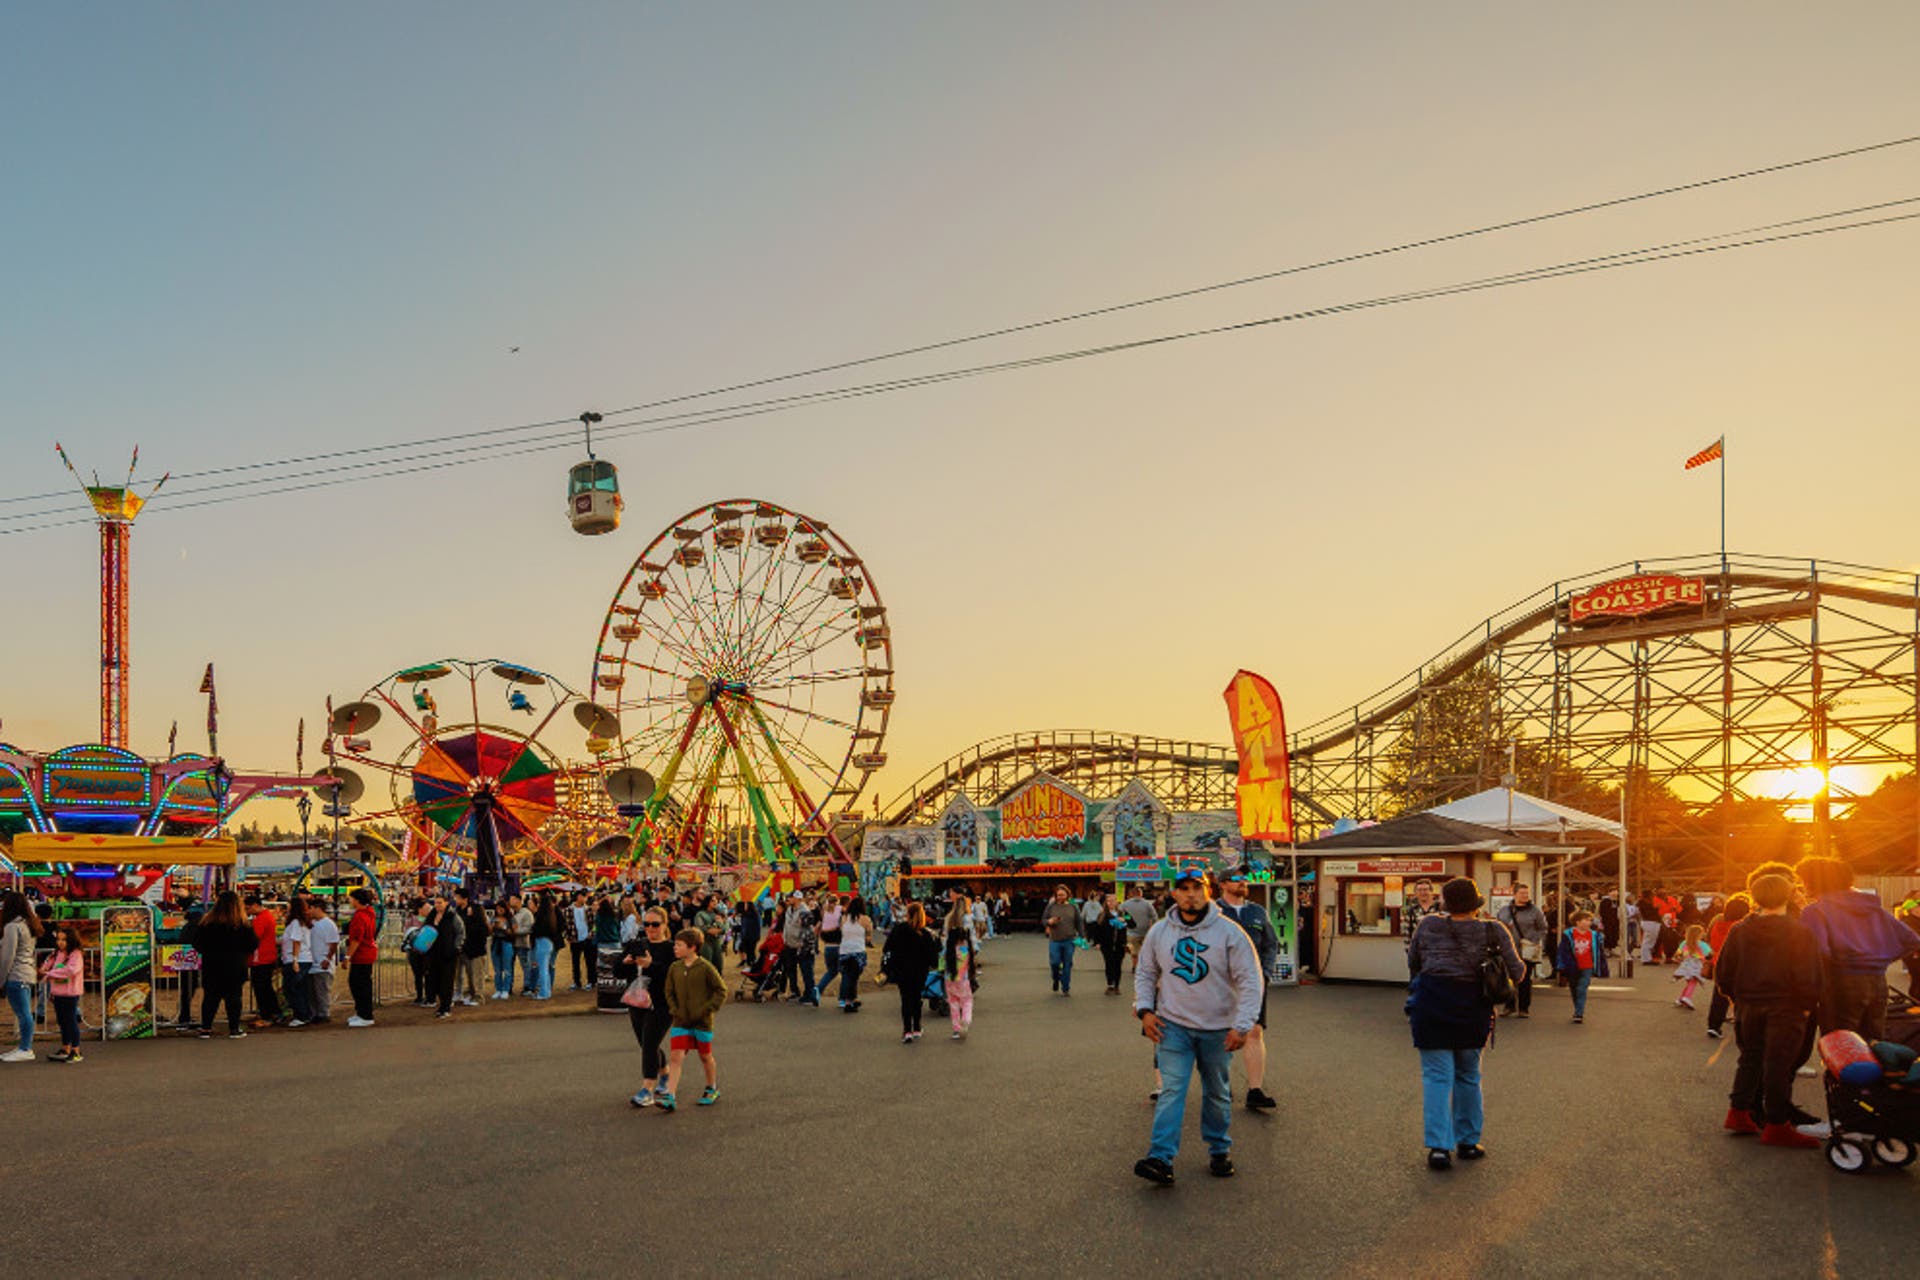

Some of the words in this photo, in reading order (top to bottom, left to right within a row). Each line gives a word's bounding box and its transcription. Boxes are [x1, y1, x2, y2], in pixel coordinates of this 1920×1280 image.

[1575, 583, 1698, 612] COASTER
[1606, 577, 1665, 595] CLASSIC
[1236, 676, 1288, 837] ATM
[53, 775, 143, 795] TORNADO
[1002, 783, 1085, 819] HAUNTED
[1002, 817, 1084, 841] MANSION
[1277, 907, 1289, 955] ATM
